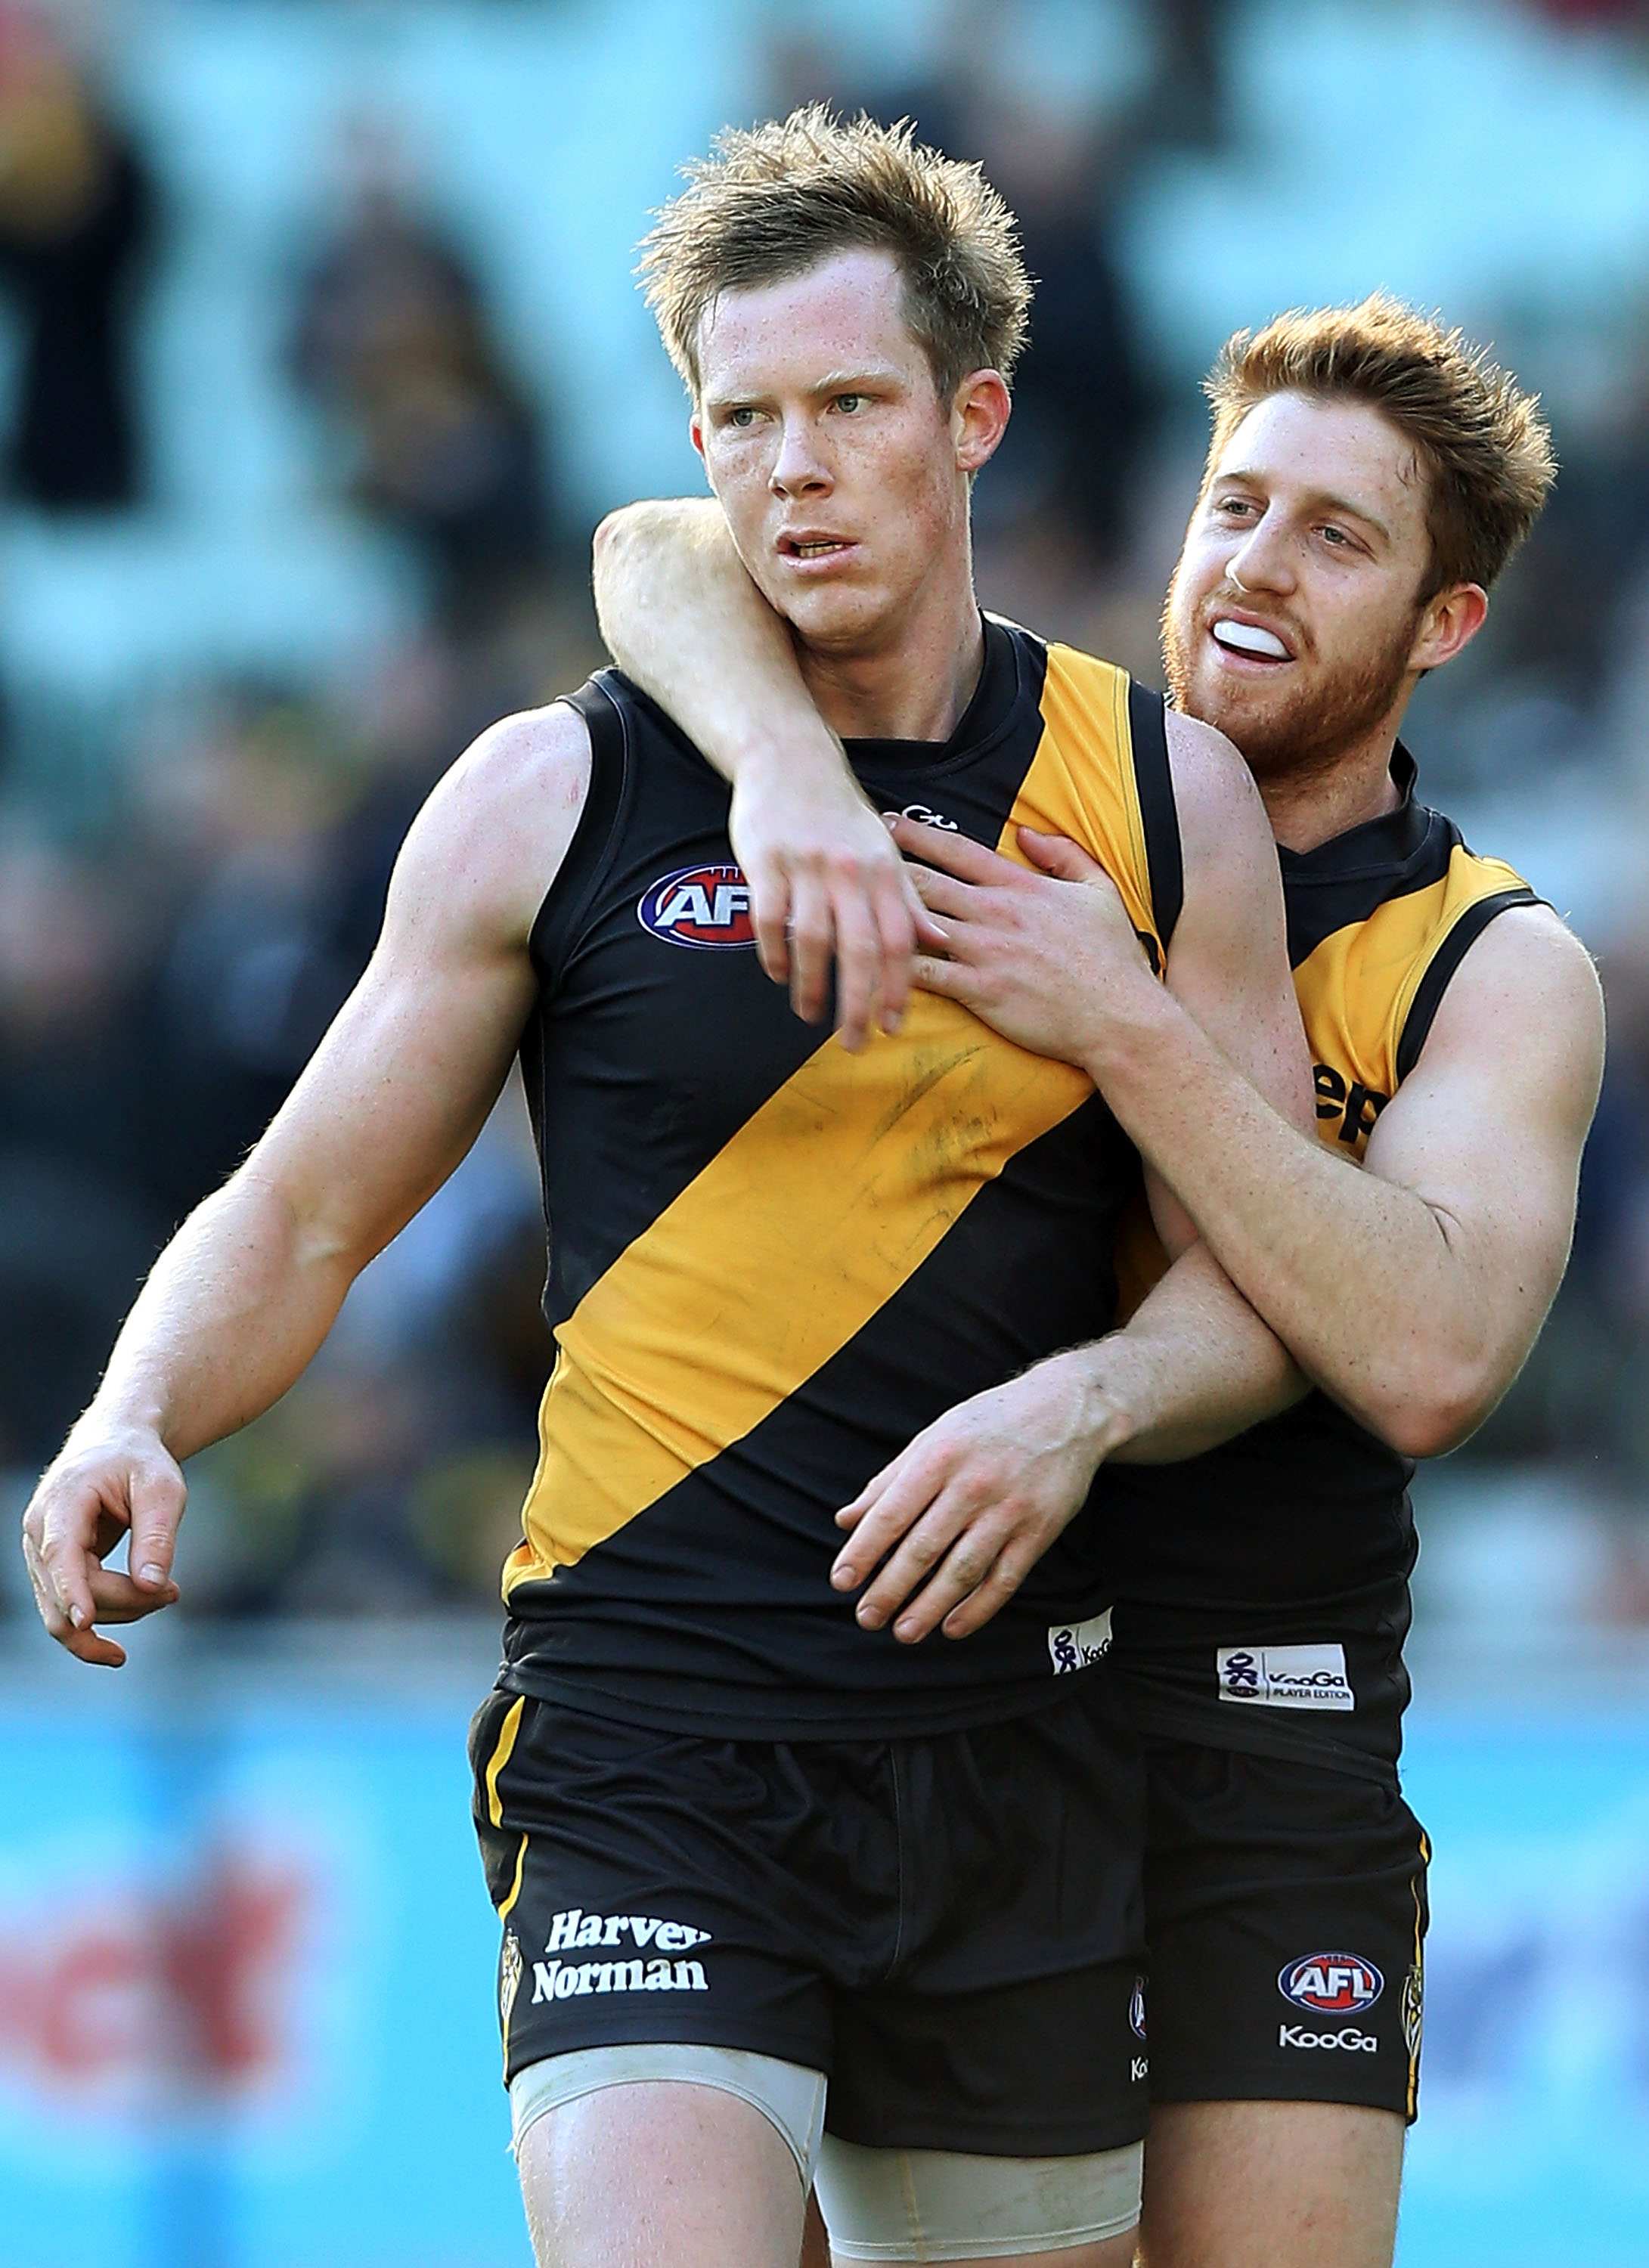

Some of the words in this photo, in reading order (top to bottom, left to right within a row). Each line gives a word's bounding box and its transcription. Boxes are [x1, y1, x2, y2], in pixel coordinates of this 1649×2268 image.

[653, 885, 749, 927] AF
[1313, 1064, 1392, 1145] ep
[1272, 1688, 1312, 1698] PLAYER
[1313, 1689, 1351, 1699] EDITION
[544, 1909, 712, 1953] Harvey
[531, 1959, 709, 2004] Norman
[1290, 1966, 1374, 1998] AFL
[1279, 2024, 1378, 2053] KooGa
